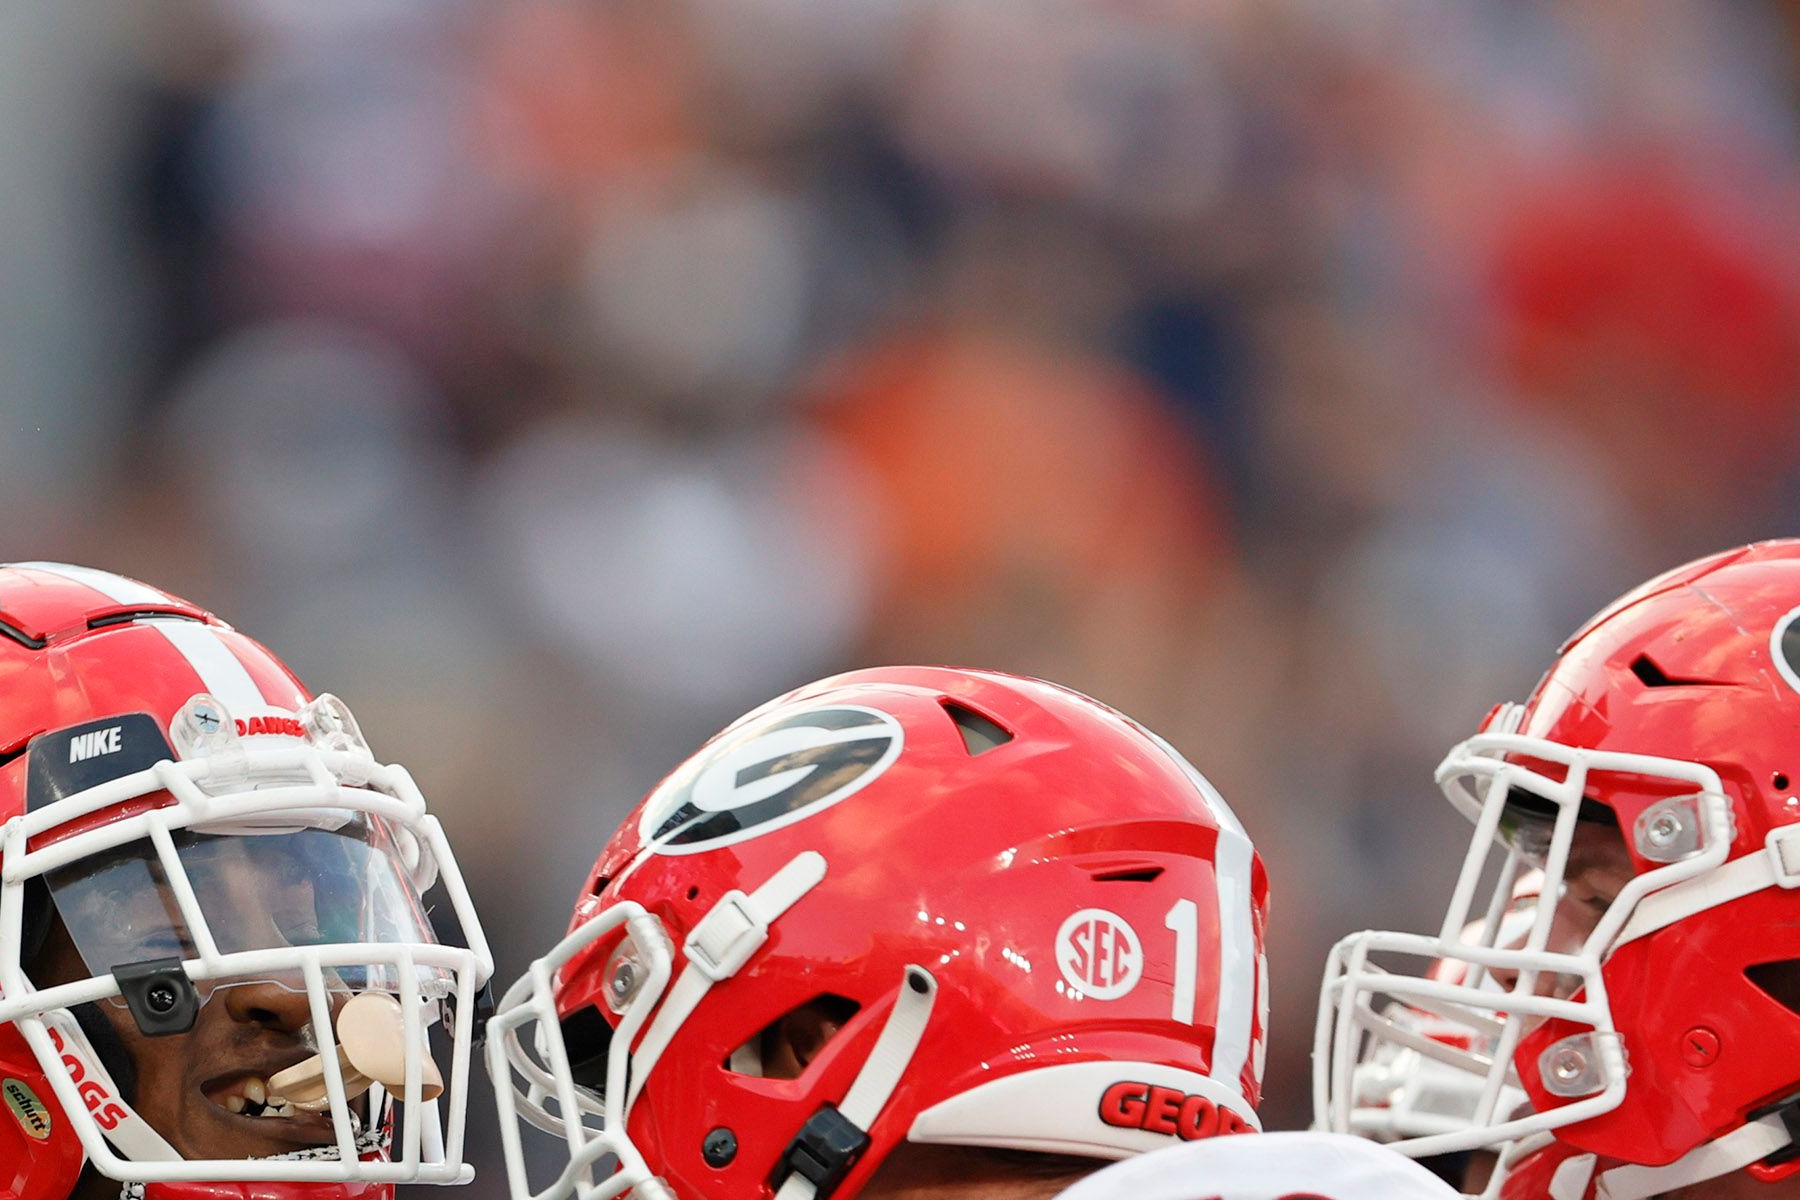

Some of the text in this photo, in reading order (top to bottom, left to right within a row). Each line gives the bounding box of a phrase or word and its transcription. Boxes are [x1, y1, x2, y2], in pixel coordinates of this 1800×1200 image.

[69, 726, 122, 764] NIKE
[650, 709, 894, 846] G
[1068, 918, 1132, 989] SEC
[6, 1083, 47, 1132] schutt
